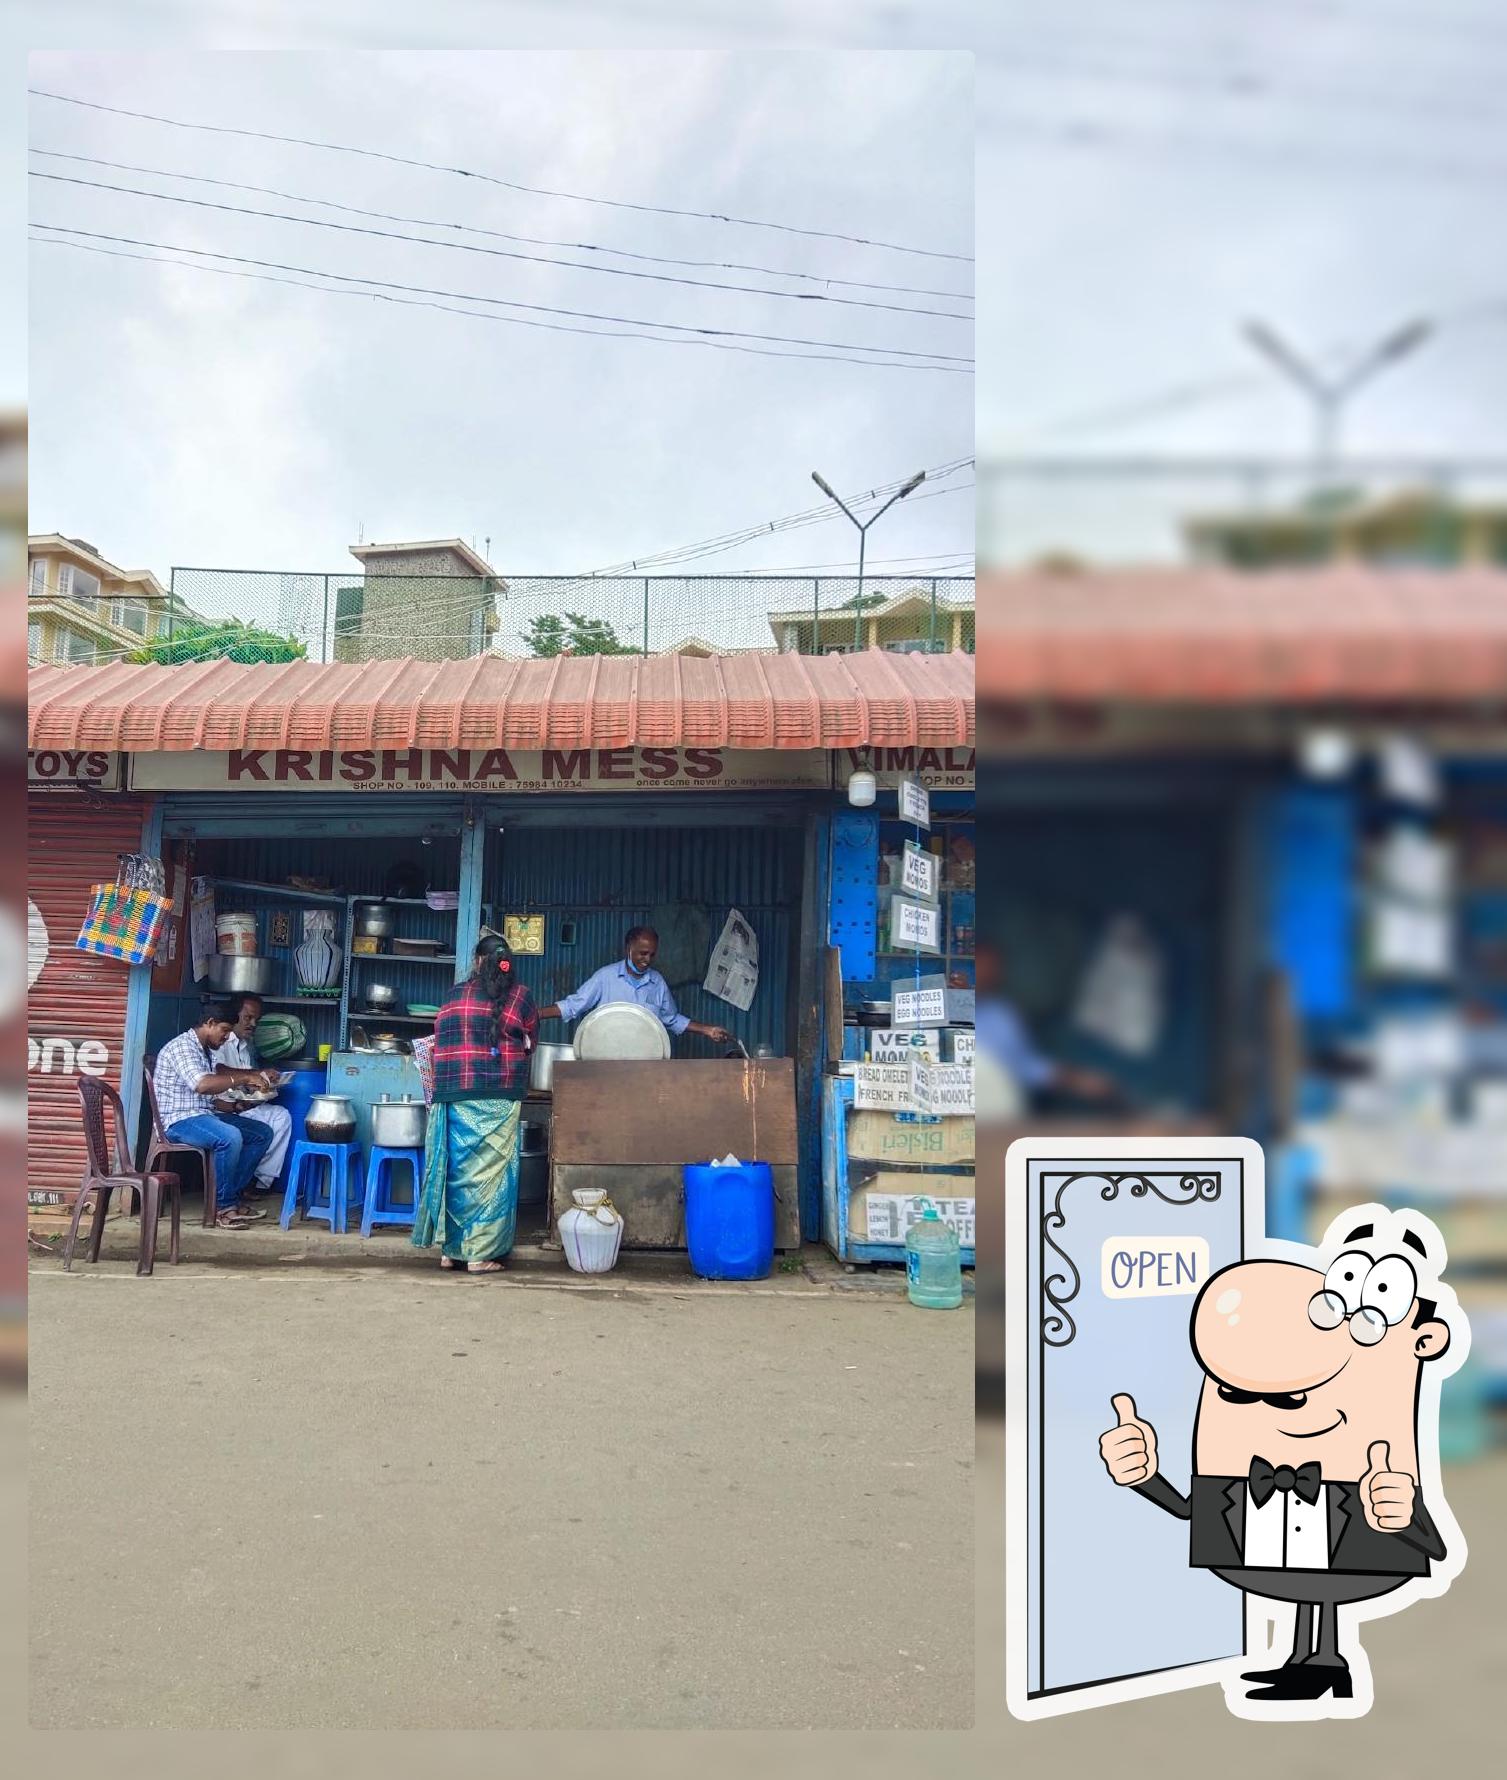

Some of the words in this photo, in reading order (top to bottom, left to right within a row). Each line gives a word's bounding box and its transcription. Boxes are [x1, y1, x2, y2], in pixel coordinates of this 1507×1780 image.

[228, 749, 517, 781] KRISHNA
[542, 749, 723, 780] MESS
[353, 781, 384, 790] SHOP
[387, 781, 404, 790] NO
[462, 780, 506, 789] MOBILE
[636, 778, 660, 786] once
[663, 778, 690, 786] come
[693, 777, 720, 786] never
[724, 778, 738, 788] go
[946, 776, 965, 785] NO
[909, 854, 926, 875] VEG
[897, 994, 910, 1005] VEG
[912, 991, 942, 1003] NOODLES
[897, 1008, 911, 1019] EGG
[912, 1006, 943, 1018] NOODLES
[878, 1033, 927, 1046] VEG
[858, 1067, 880, 1082] BREAD
[859, 1088, 893, 1102] FRENCH
[881, 1131, 943, 1154] Bisleri
